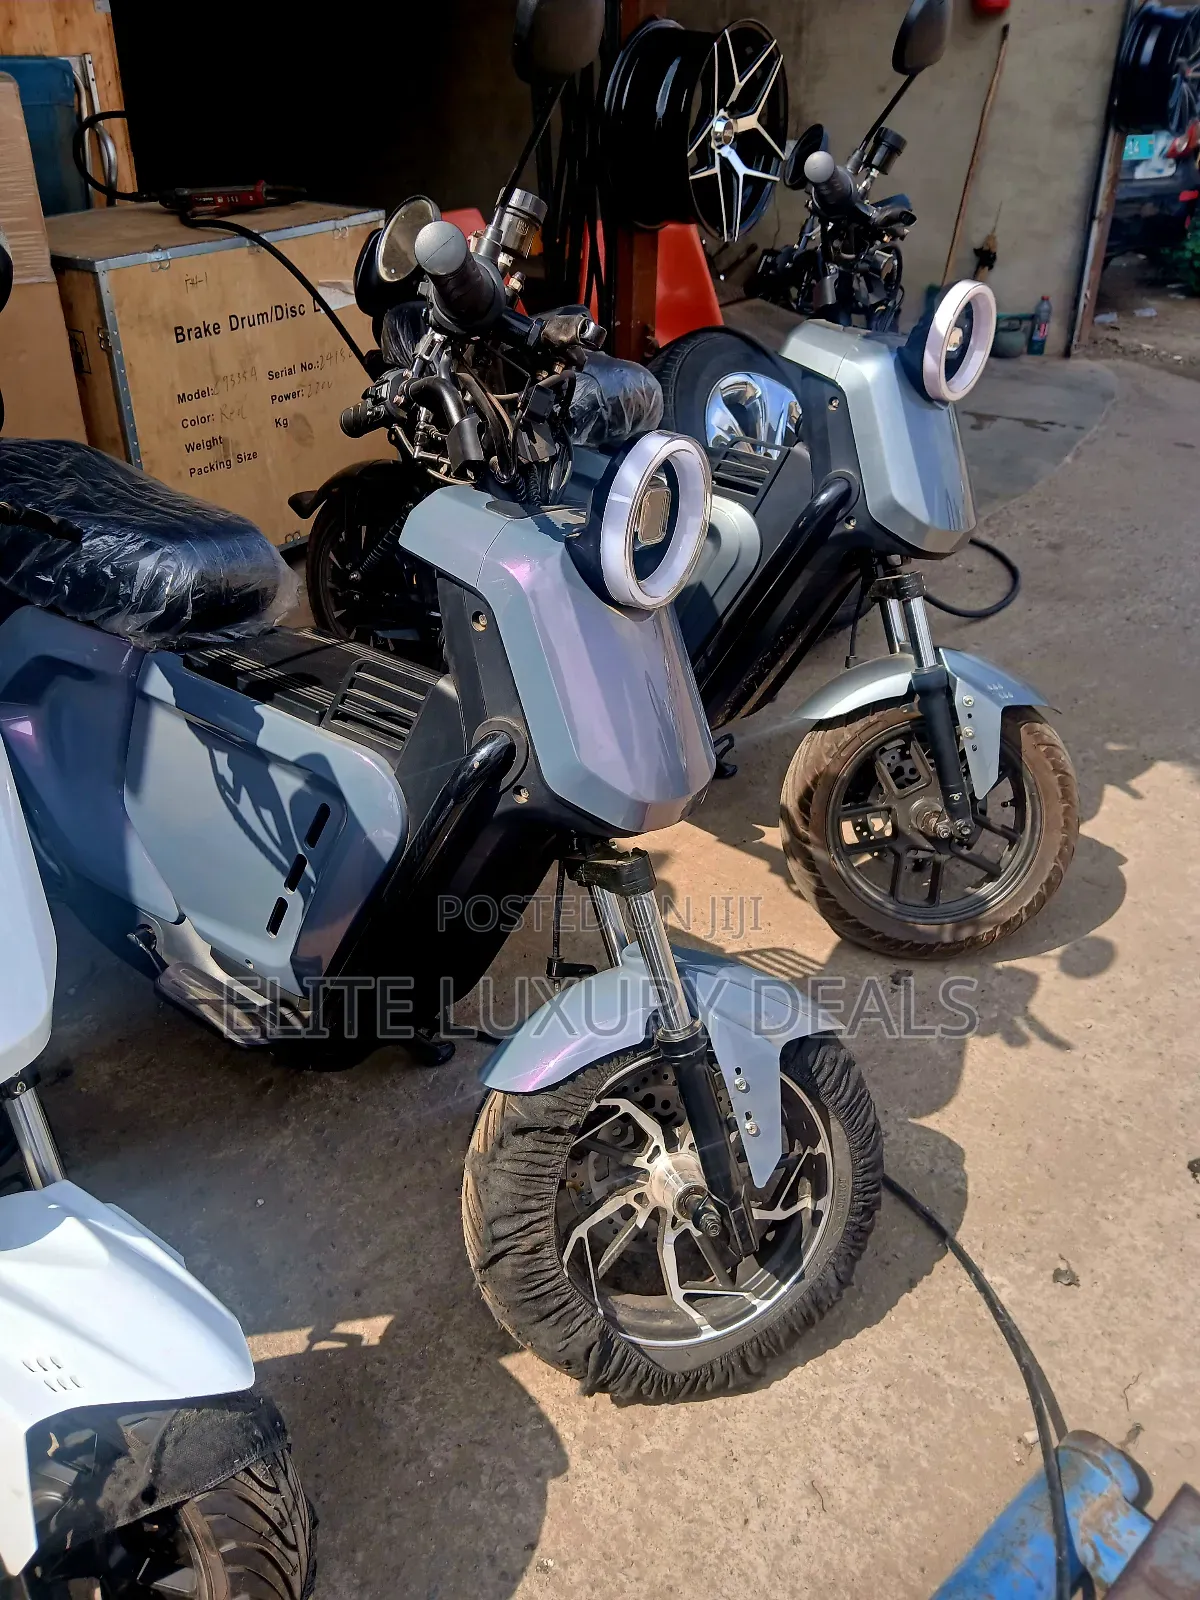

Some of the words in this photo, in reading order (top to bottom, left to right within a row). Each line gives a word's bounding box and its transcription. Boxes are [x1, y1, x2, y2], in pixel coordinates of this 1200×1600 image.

[174, 320, 221, 343] Brake
[228, 303, 306, 332] Drum/Disc
[267, 364, 296, 381] Serial
[300, 361, 320, 373] No.:
[177, 386, 214, 404] Model:
[270, 389, 304, 405] Power:
[181, 413, 215, 429] Color:
[275, 418, 289, 429] Kg
[185, 435, 224, 453] Weight
[189, 456, 232, 478] Packing
[236, 451, 258, 463] Size
